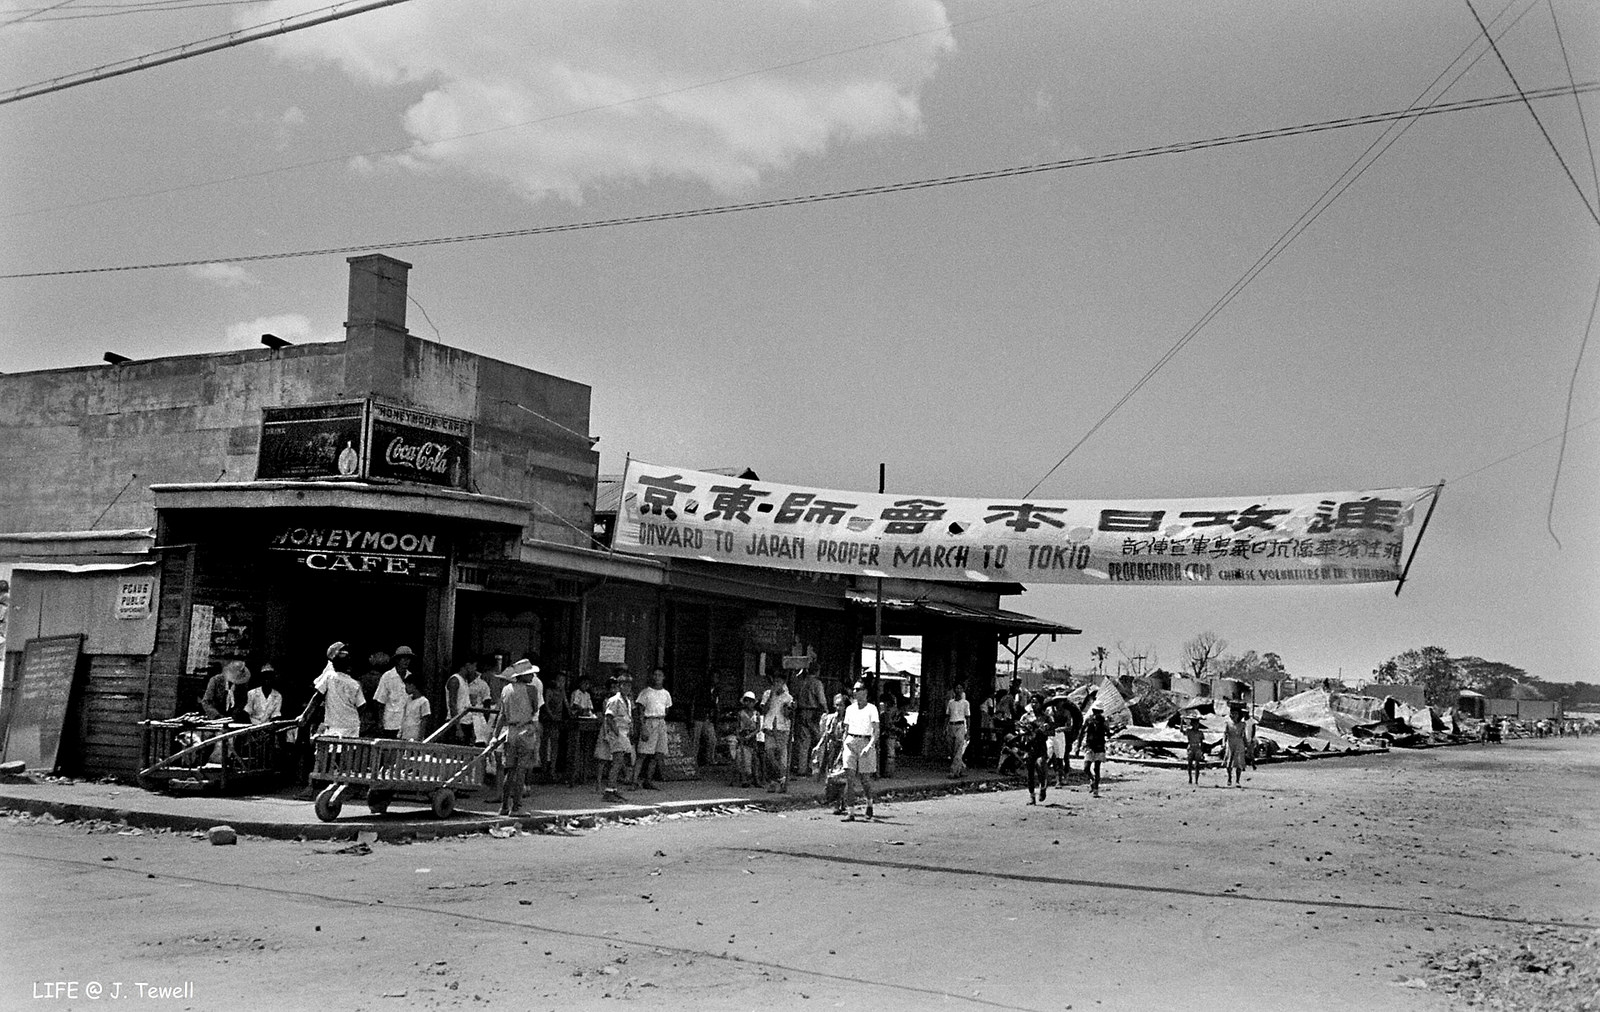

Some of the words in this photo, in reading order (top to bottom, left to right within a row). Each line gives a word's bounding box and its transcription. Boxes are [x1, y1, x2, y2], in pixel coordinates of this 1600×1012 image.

[638, 522, 704, 549] ONWARD
[714, 529, 734, 552] TO
[746, 533, 805, 561] JAPAN
[816, 538, 880, 567] PROPER
[892, 544, 970, 569] MARCH
[983, 544, 1008, 570] TO
[1028, 544, 1091, 570] TOKIO
[305, 553, 409, 576] CAFE
[1108, 562, 1182, 582] PROPAGANDA
